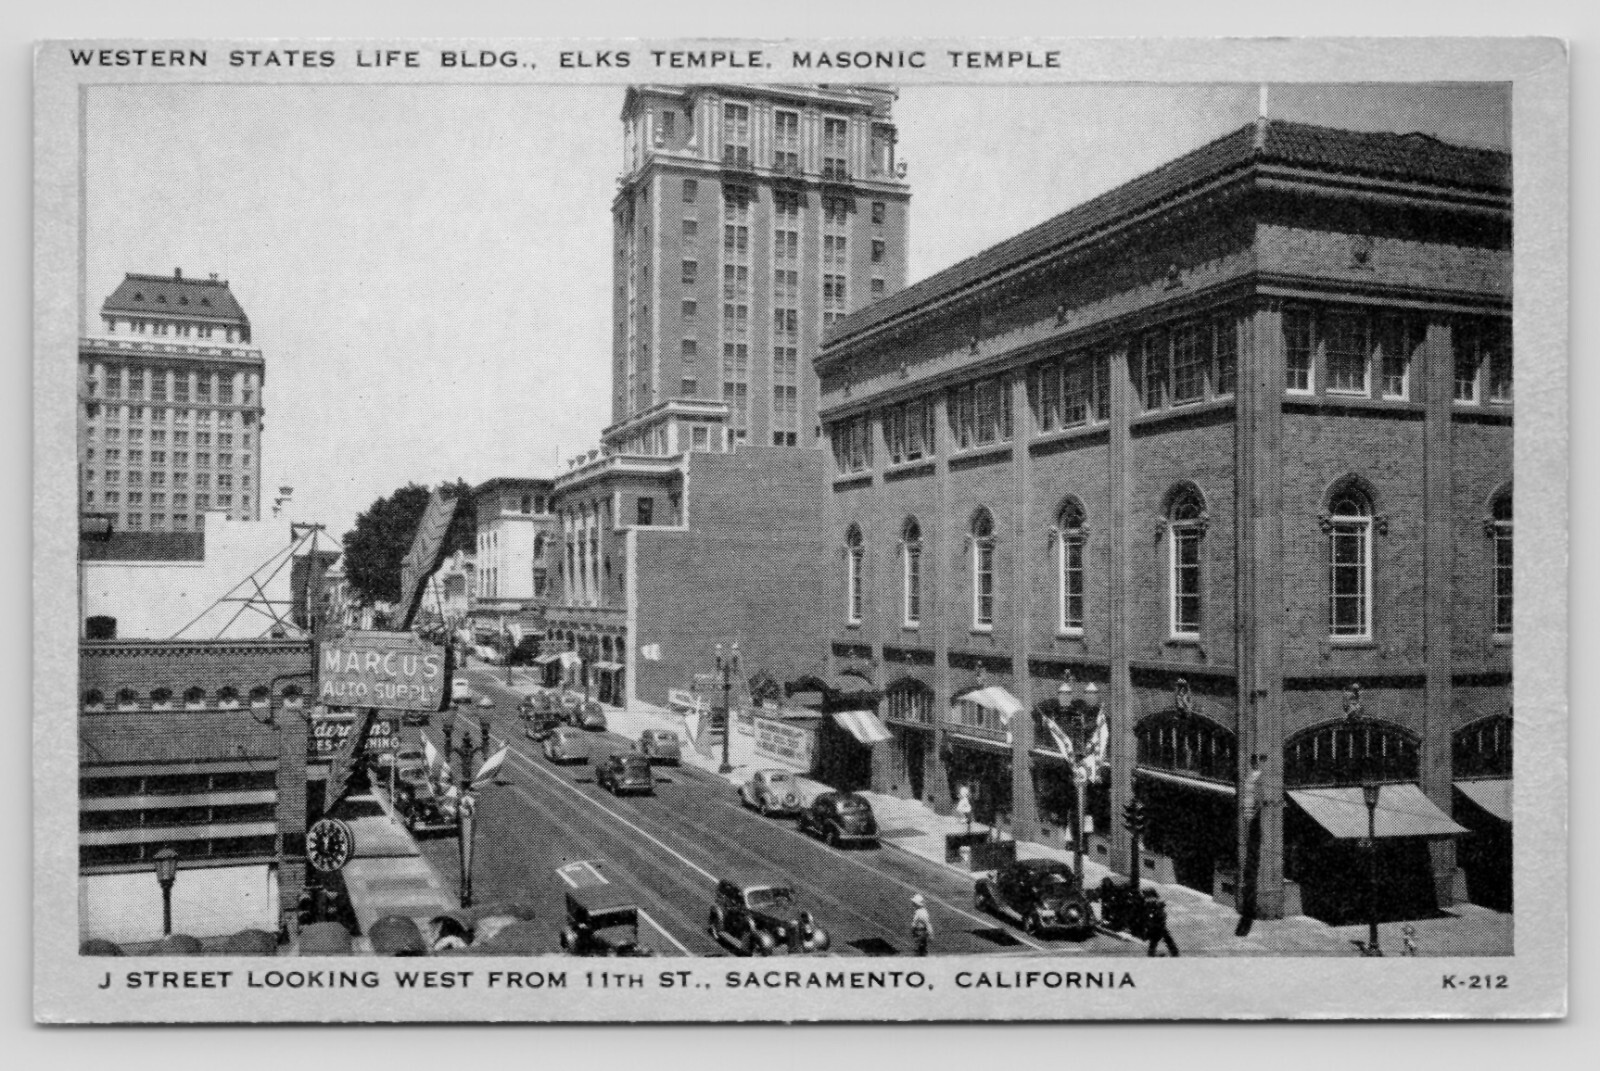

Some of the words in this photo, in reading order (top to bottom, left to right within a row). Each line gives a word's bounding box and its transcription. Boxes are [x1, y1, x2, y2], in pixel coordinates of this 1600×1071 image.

[325, 649, 438, 678] MARCUS
[322, 680, 369, 697] AUTO
[373, 682, 439, 702] SUPPLY
